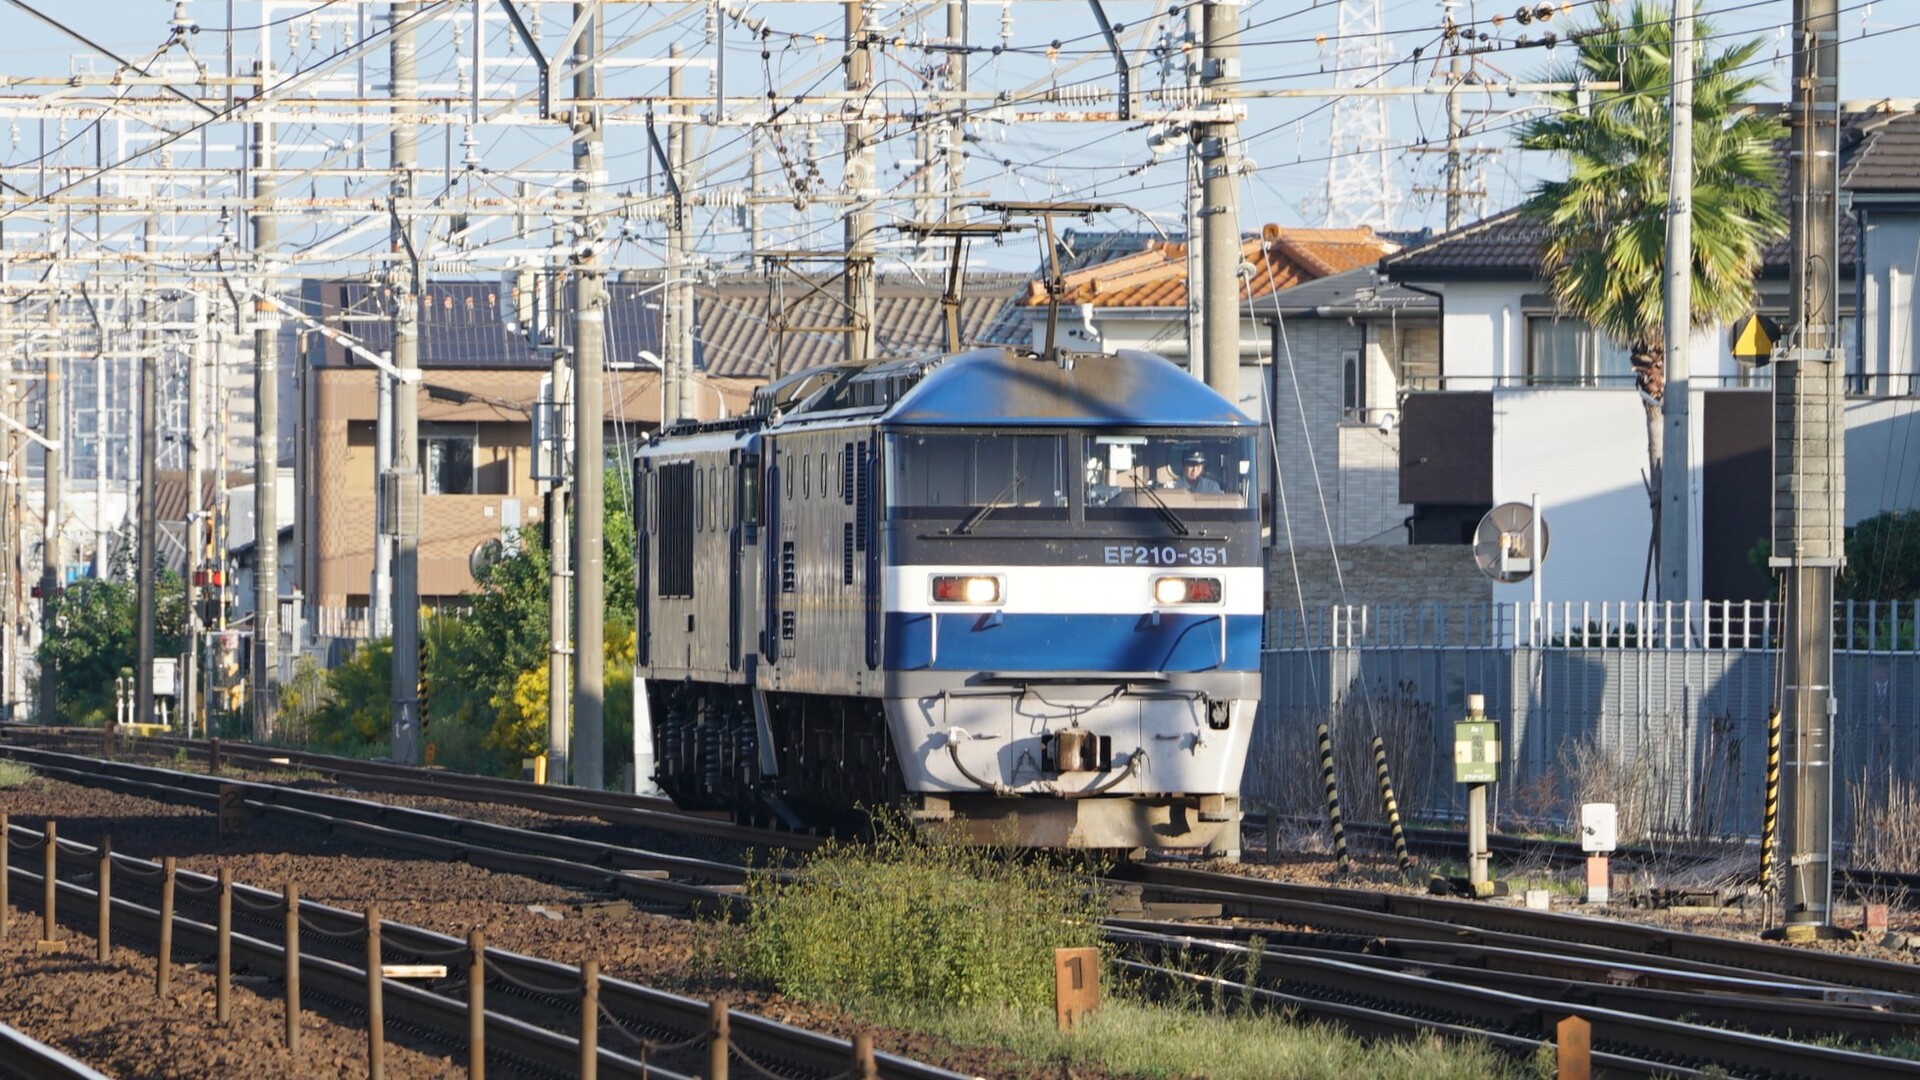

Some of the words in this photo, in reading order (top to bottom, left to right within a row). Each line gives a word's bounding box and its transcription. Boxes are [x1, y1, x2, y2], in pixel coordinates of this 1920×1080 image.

[1103, 545, 1228, 565] EF210-351
[225, 791, 241, 809] 2
[1064, 956, 1083, 990] 1
